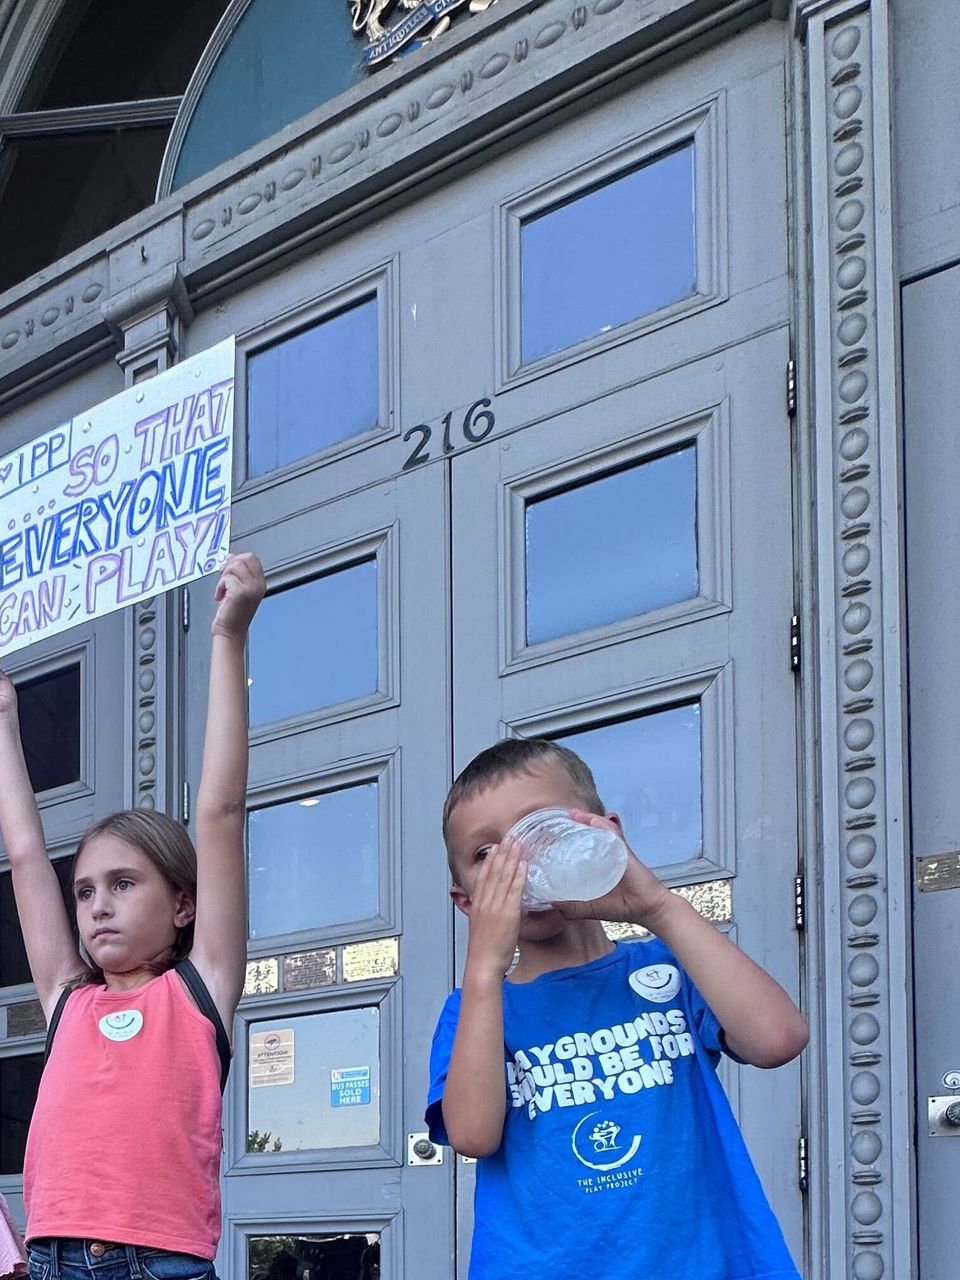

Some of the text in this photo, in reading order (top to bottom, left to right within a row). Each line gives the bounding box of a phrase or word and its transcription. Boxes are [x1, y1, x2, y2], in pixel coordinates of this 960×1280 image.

[63, 377, 234, 498] SO THAT
[402, 398, 495, 471] 216
[17, 432, 66, 486] IPP
[86, 505, 230, 615] PLAY!
[599, 1045, 644, 1077] BE
[649, 1032, 695, 1060] FOR
[331, 1080, 369, 1090] BUS PASSES
[339, 1088, 362, 1097] SOLD
[340, 1096, 362, 1104] HERE
[528, 1060, 674, 1121] EVERYONE
[577, 1168, 643, 1187] THE INCLUSIVE
[606, 1177, 638, 1190] PROJECT
